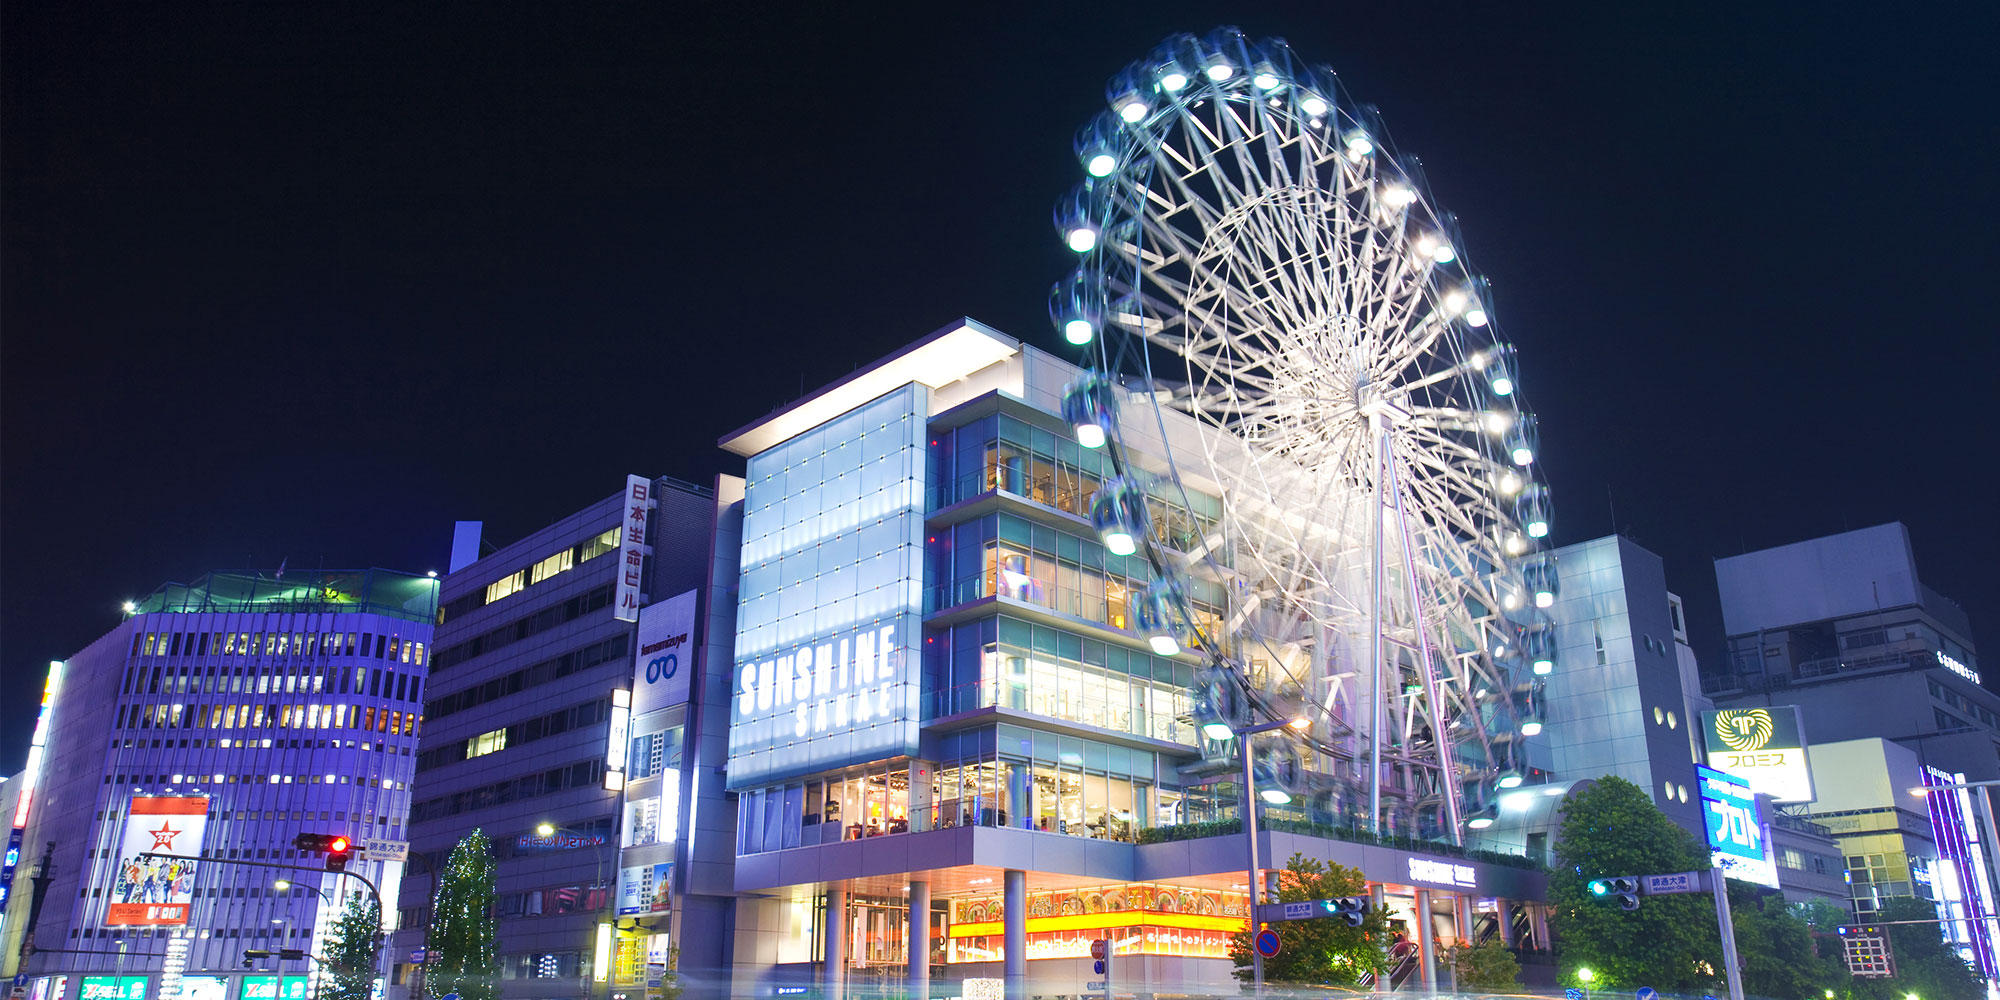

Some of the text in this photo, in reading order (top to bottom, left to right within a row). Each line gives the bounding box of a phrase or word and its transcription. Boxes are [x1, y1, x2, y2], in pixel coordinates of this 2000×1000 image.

[622, 483, 647, 609] 日本生命ビル
[739, 624, 895, 716] SUNSHINE
[795, 681, 891, 737] SAKAE
